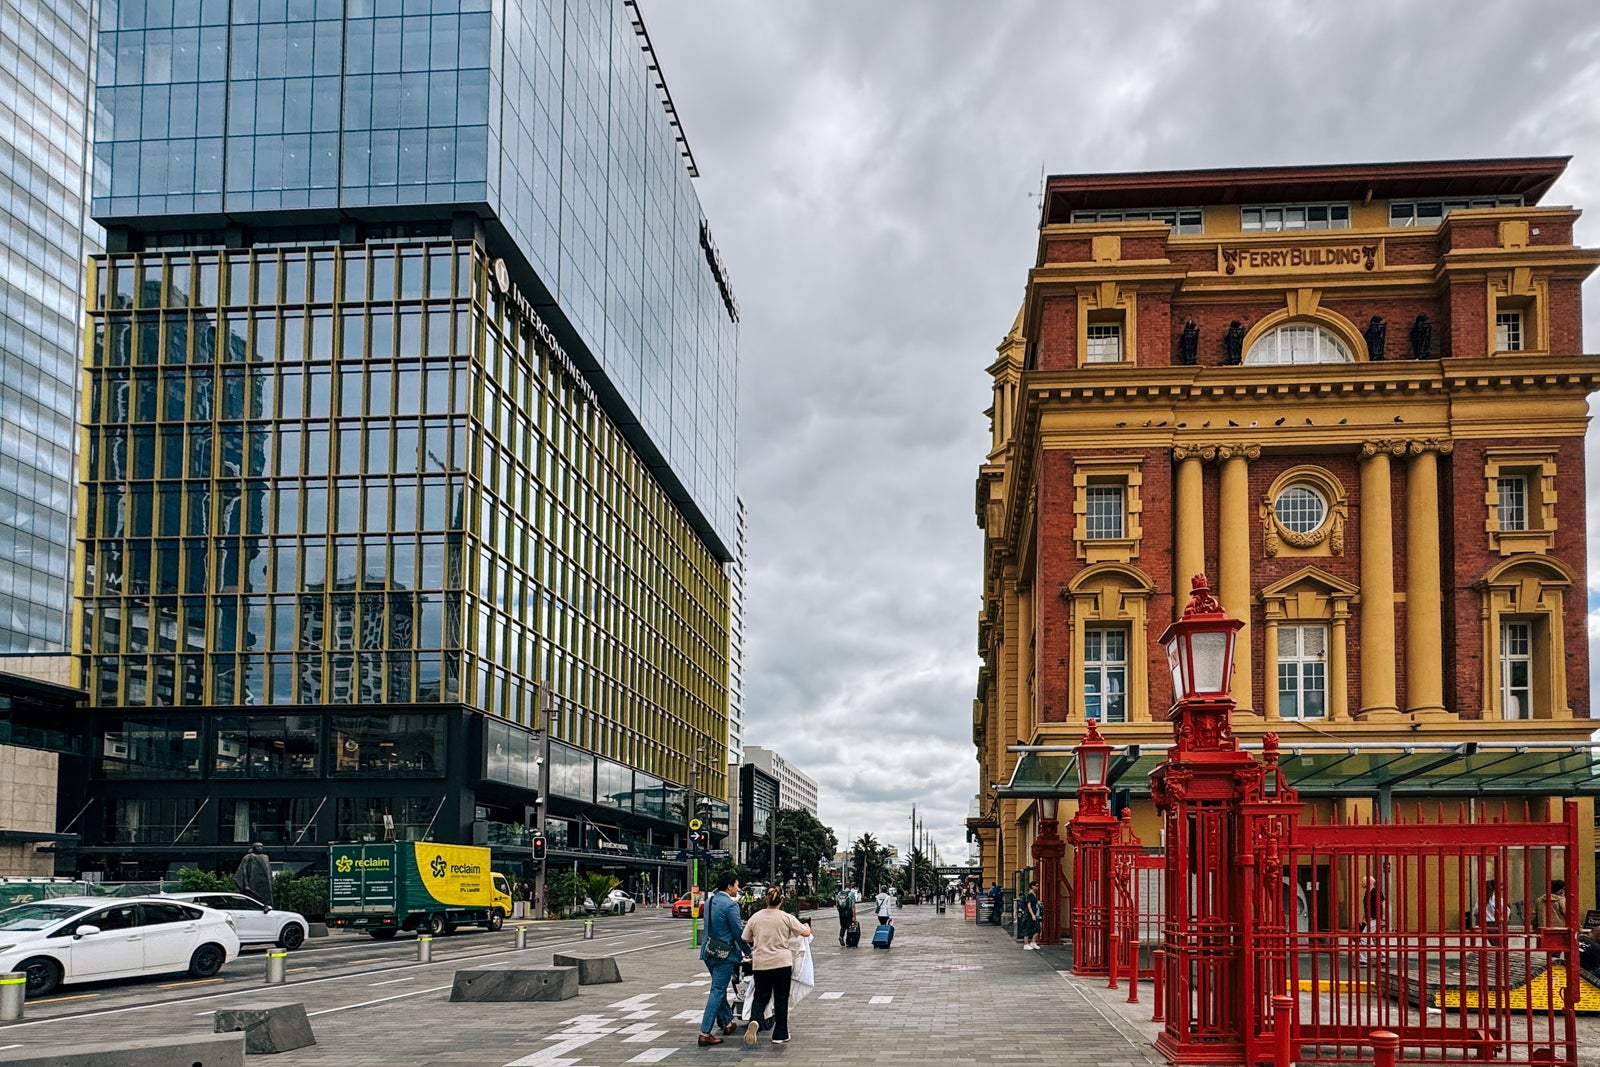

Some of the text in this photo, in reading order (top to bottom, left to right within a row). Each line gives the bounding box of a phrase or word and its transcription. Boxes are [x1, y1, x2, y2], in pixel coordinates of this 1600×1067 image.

[1238, 248, 1361, 268] FERRY BUILDING
[513, 282, 601, 410] INTERCONTINENTAL
[354, 857, 390, 867] reclaim
[450, 863, 480, 874] reclaim
